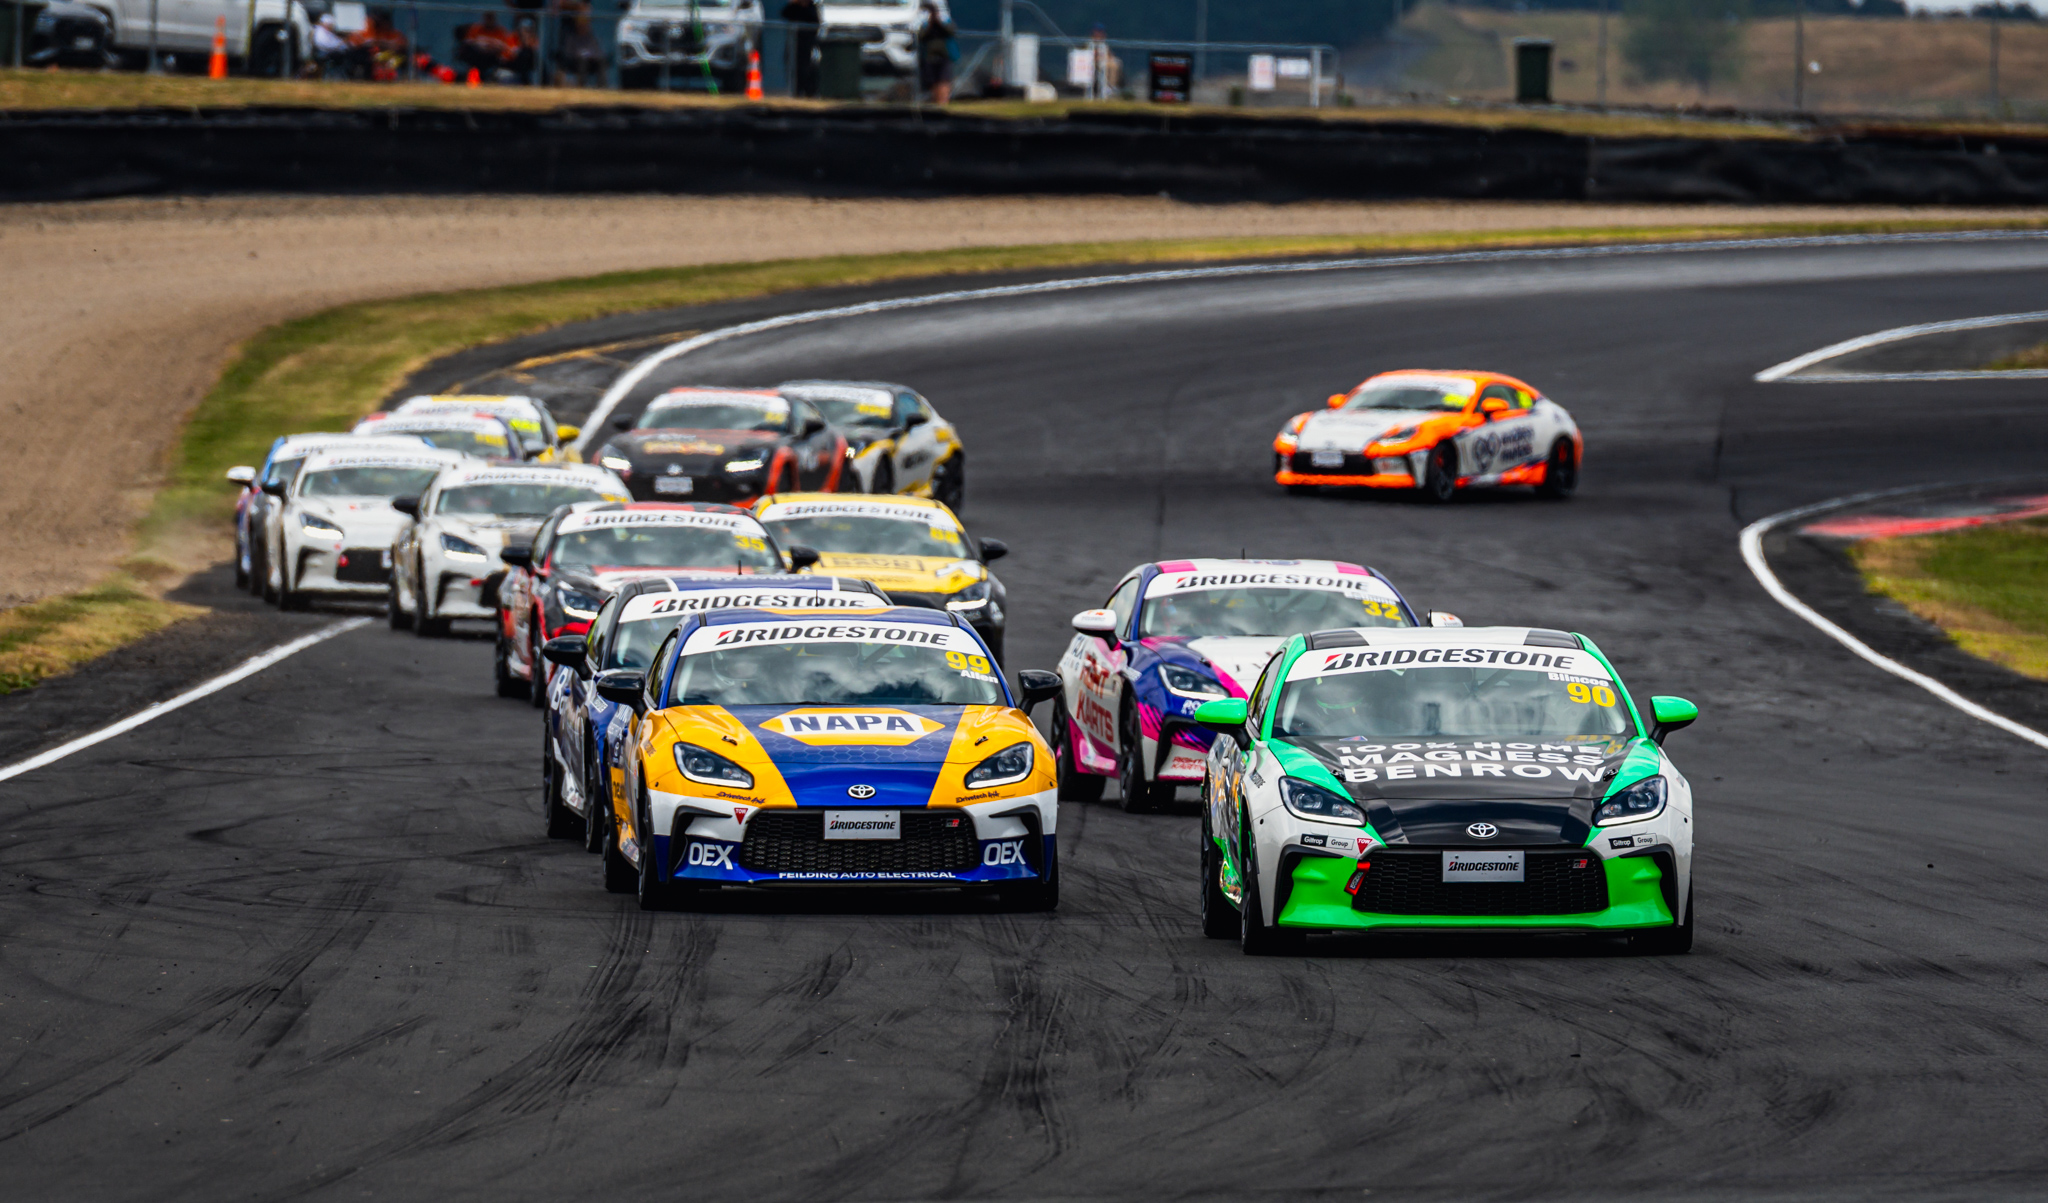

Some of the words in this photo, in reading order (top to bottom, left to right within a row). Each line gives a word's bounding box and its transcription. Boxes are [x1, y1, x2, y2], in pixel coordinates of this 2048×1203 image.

[583, 513, 743, 528] BRIDGESTONE
[784, 505, 934, 520] BRIDGESTONE
[735, 534, 766, 552] 35
[1176, 573, 1369, 592] BRIDGESTONE
[651, 594, 864, 613] BRIDGESTONE
[1362, 600, 1401, 621] 32
[715, 626, 949, 646] BRIDGESTONE
[945, 650, 990, 675] 99
[1322, 649, 1574, 671] BRIDGESTONE
[961, 669, 998, 684] Allen
[1548, 672, 1609, 687] Blincoe
[1567, 682, 1616, 708] 90
[789, 715, 915, 732] NAPA
[1076, 689, 1114, 743] KARTS
[1337, 742, 1458, 754] 100%
[1473, 741, 1602, 755] HOME
[1339, 750, 1605, 766] MAGNESS
[1343, 763, 1607, 783] BENROW
[956, 793, 987, 803] Drivetech
[829, 820, 896, 830] BRIDGESTONE
[1304, 836, 1324, 845] Giltrap
[1331, 838, 1348, 848] Group
[1612, 839, 1631, 847] Giltrap
[1637, 836, 1653, 844] Group
[688, 842, 734, 870] OEX
[983, 840, 1026, 866] OEX
[1448, 861, 1519, 871] BRIDGESTONE
[877, 871, 956, 879] ELECTRICAL
